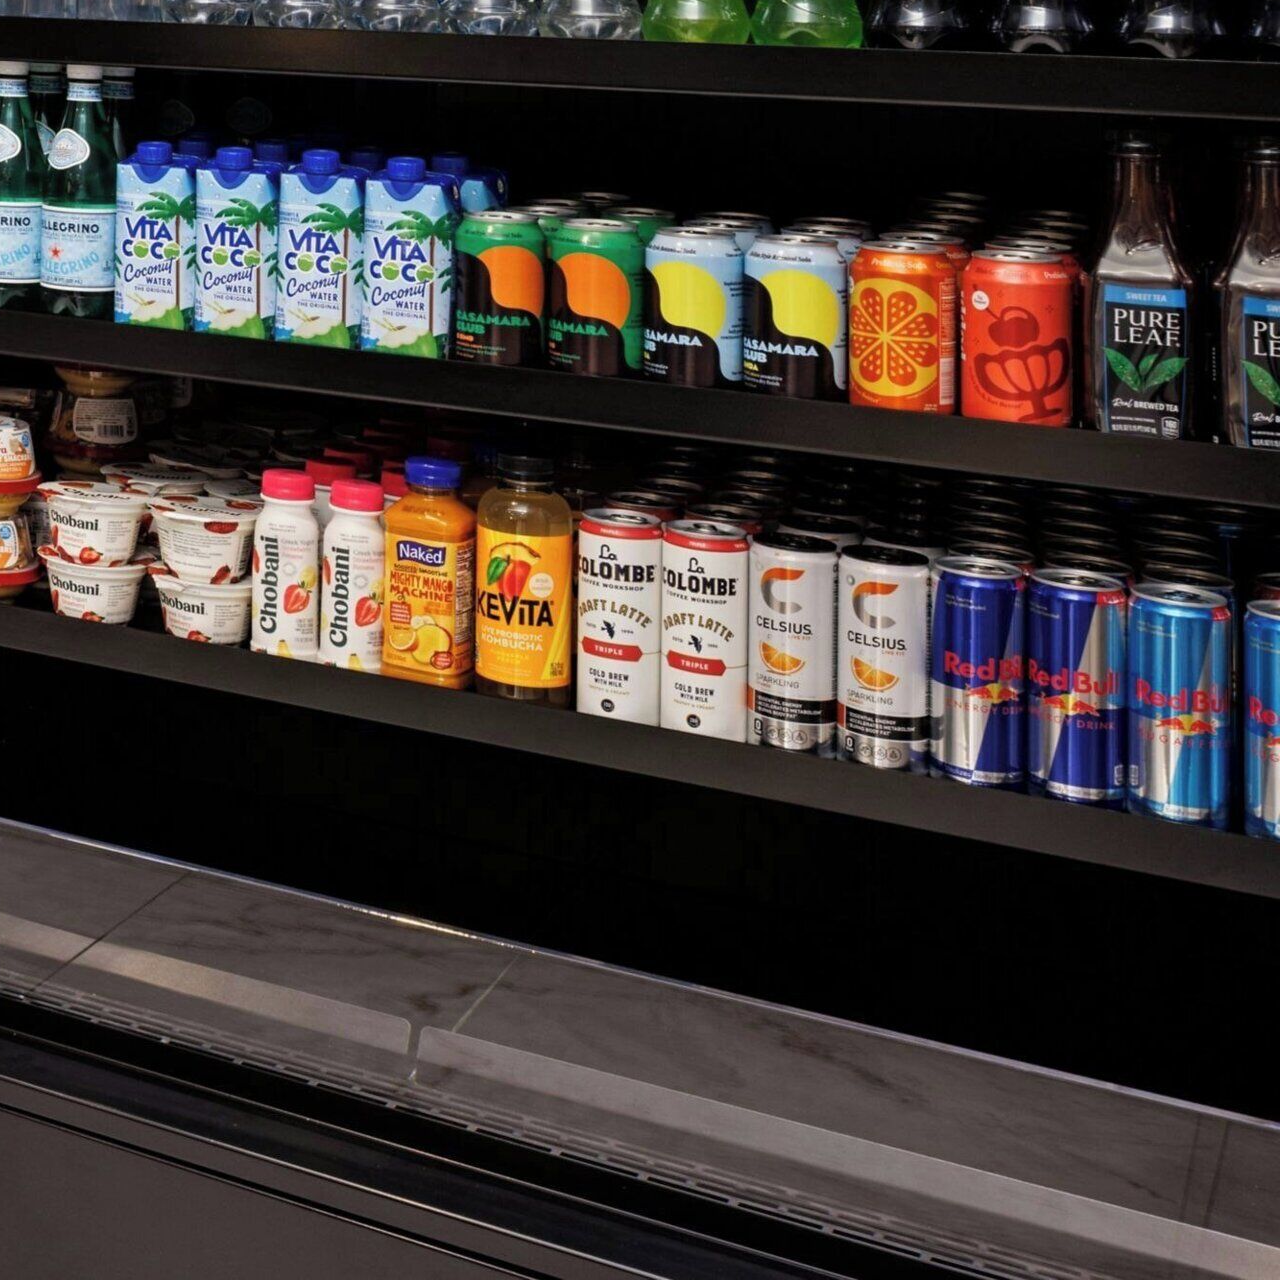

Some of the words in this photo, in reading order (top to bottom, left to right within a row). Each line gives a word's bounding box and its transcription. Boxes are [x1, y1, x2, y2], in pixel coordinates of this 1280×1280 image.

[125, 216, 173, 241] VITA
[203, 221, 253, 249] VITA
[122, 240, 181, 261] COCO
[288, 227, 340, 256] VITA
[373, 234, 426, 263] VITA
[201, 246, 262, 268] COCO
[124, 258, 175, 283] Coconut
[203, 266, 254, 291] Coconut
[134, 285, 147, 293] THE
[148, 286, 174, 295] ORIGINAL
[146, 276, 172, 287] WATER
[225, 284, 253, 295] WATER
[286, 272, 340, 297] Coconut
[309, 291, 338, 302] WATER
[371, 280, 427, 306] Coconut
[1126, 292, 1152, 301] SWEET
[1153, 294, 1167, 302] TEA
[395, 300, 426, 311] WATER
[455, 309, 531, 327] CASAMARA
[1113, 308, 1181, 330] PURE
[456, 321, 486, 335] CLUB
[1112, 398, 1133, 408] Real
[1134, 399, 1165, 411] BREWED
[1166, 404, 1179, 412] TEA
[51, 509, 99, 532] Chobani
[598, 544, 618, 561] La
[419, 567, 448, 577] SMOOTHIE
[687, 557, 705, 574] La
[51, 574, 100, 597] Chobani
[260, 534, 280, 635] Chobani
[390, 570, 421, 586] MIGHTY
[423, 578, 453, 594] MANGO
[602, 583, 644, 592] WORKSHOP
[329, 546, 350, 648] Chobani
[390, 584, 453, 603] MACHINE
[690, 597, 728, 605] WORKSHOP
[579, 598, 606, 617] DRAFT
[611, 601, 652, 629] LATTE
[497, 628, 543, 641] PROBIOTIC
[664, 612, 695, 631] DRAFT
[698, 615, 735, 643] LATTE
[756, 615, 812, 635] CELSIUS
[481, 632, 543, 652] KOMBUCHA
[594, 644, 624, 656] TRIPLE
[847, 630, 907, 651] CELSIUS
[589, 667, 606, 678] COLD
[608, 672, 629, 682] BREW
[680, 659, 709, 671] TRIPLE
[944, 650, 996, 681] Red
[594, 677, 608, 686] WITH
[609, 679, 622, 688] MILK
[756, 673, 800, 689] SPARKLING
[1029, 658, 1068, 691] Red
[1073, 668, 1120, 696] Bull
[674, 681, 692, 693] COLD
[695, 687, 715, 696] BREW
[680, 692, 694, 700] WITH
[694, 694, 708, 703] MILK
[847, 688, 893, 705] SPARKLING
[1137, 678, 1189, 712] Red
[1077, 720, 1116, 731] DRINK
